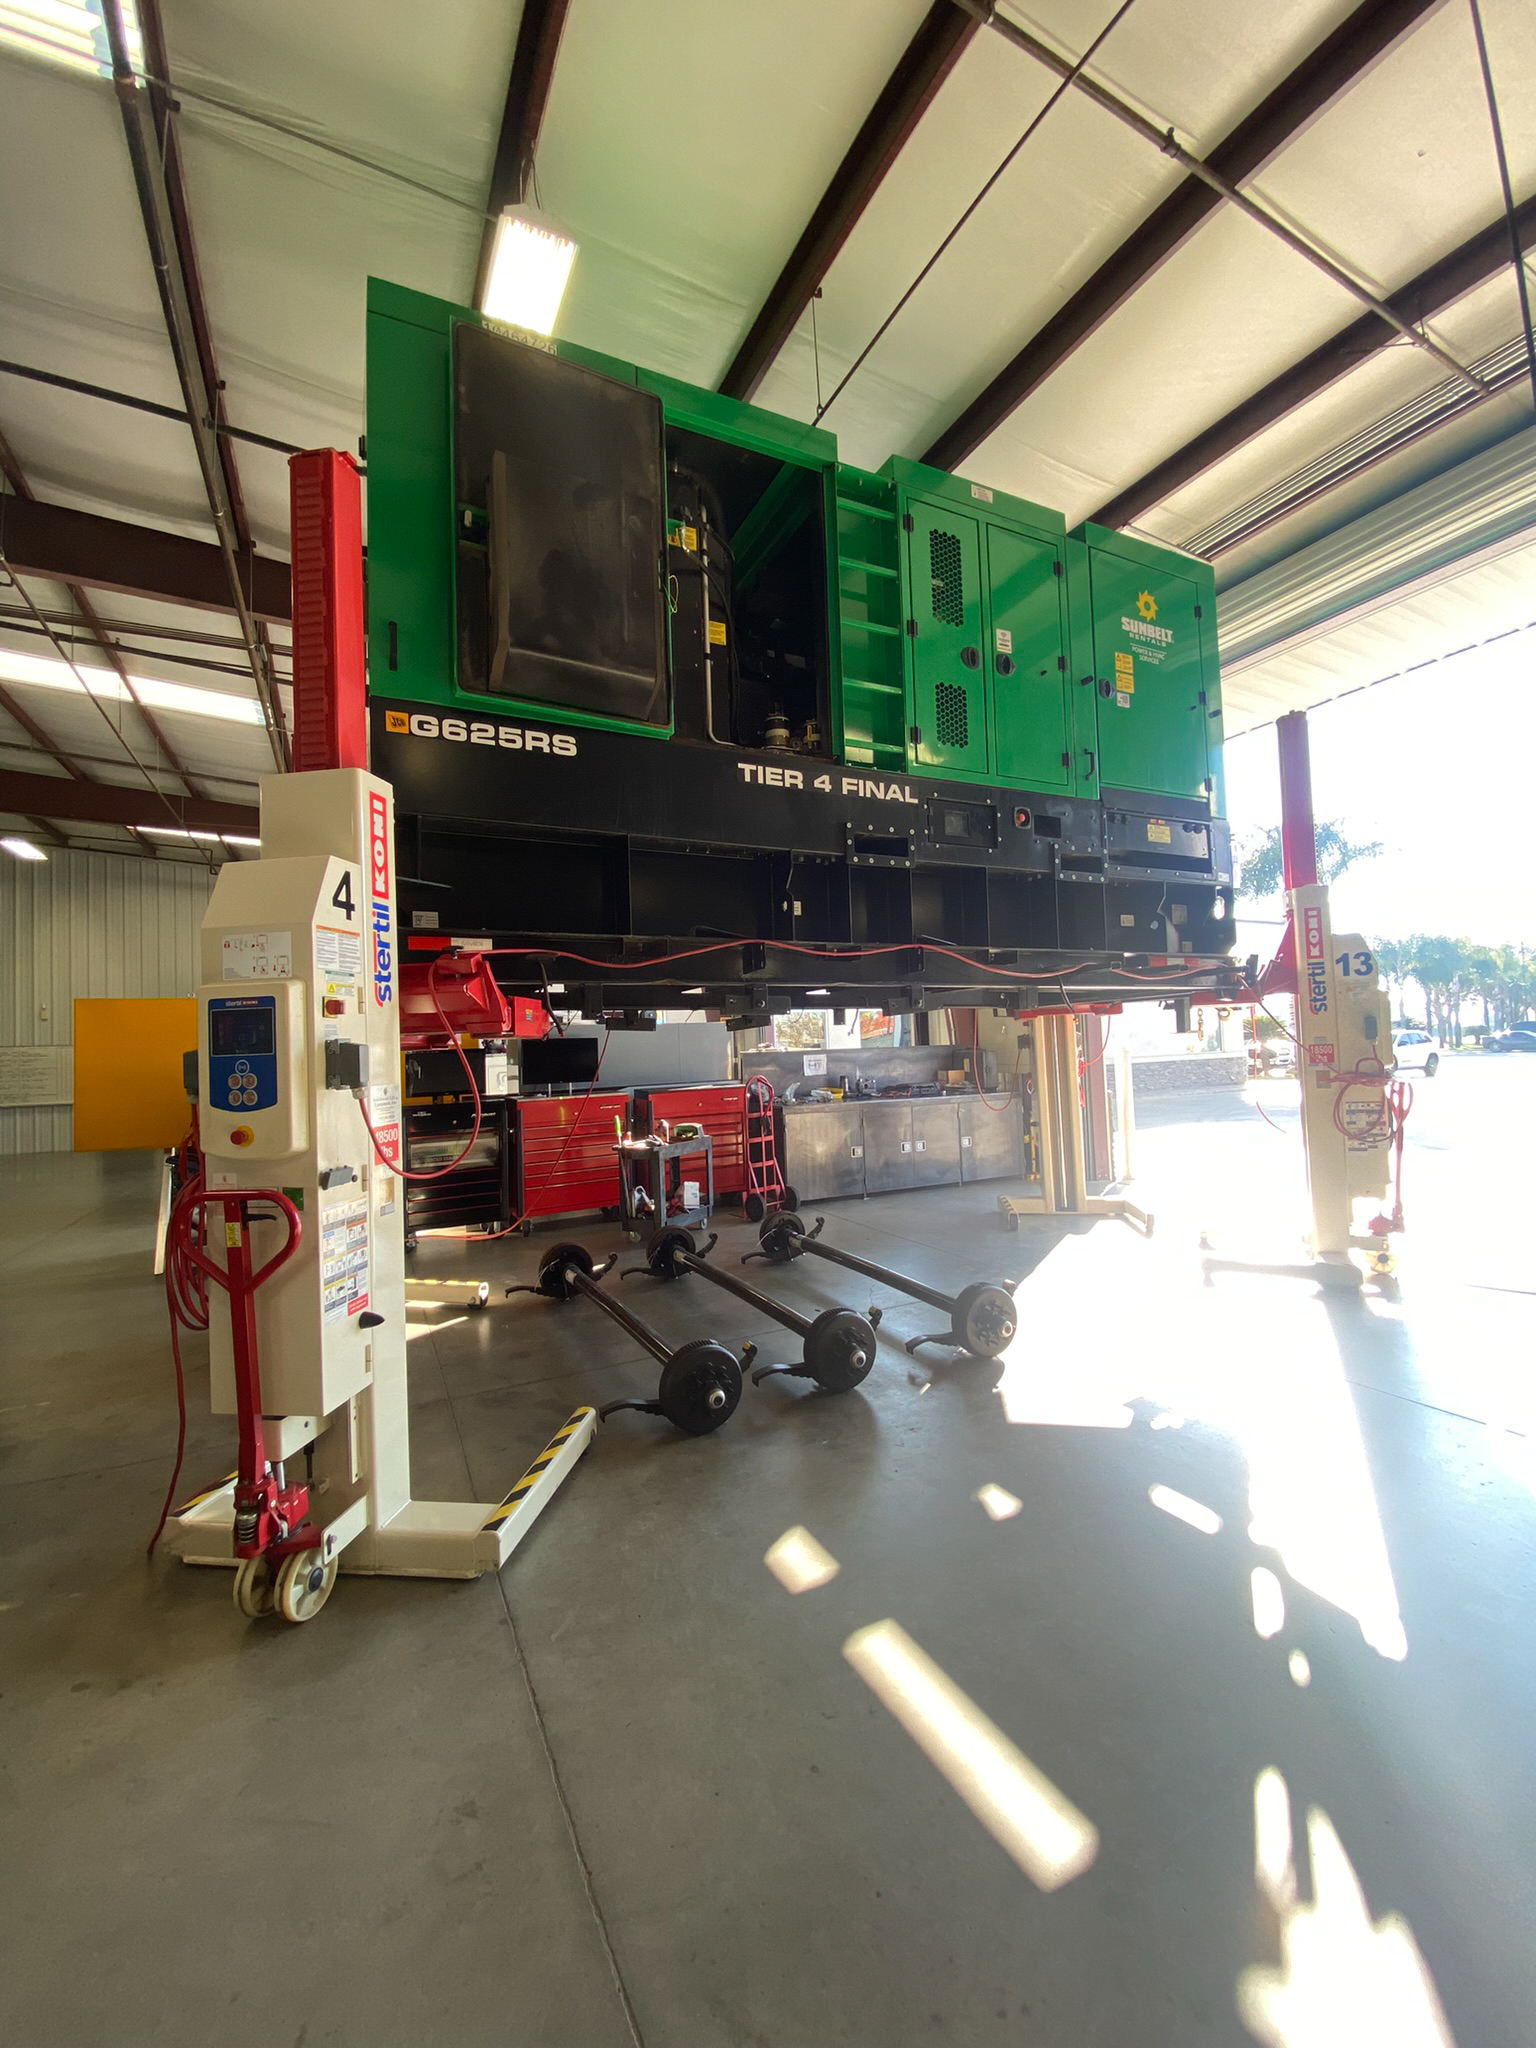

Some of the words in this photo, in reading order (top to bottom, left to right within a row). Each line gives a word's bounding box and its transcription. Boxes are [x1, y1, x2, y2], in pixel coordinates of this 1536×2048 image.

[1121, 616, 1173, 643] SUNBELT
[1129, 632, 1167, 647] RENTALS
[410, 714, 578, 757] G625RS
[737, 762, 804, 790] TIER
[813, 774, 833, 793] 4
[841, 777, 919, 804] FINAL
[372, 797, 386, 895] KONI
[332, 870, 356, 921] 4
[1307, 909, 1321, 957] KONI
[372, 902, 392, 1008] stertil
[1335, 951, 1374, 977] 13
[1307, 961, 1327, 1015] stertil
[1310, 1045, 1333, 1054] 18500
